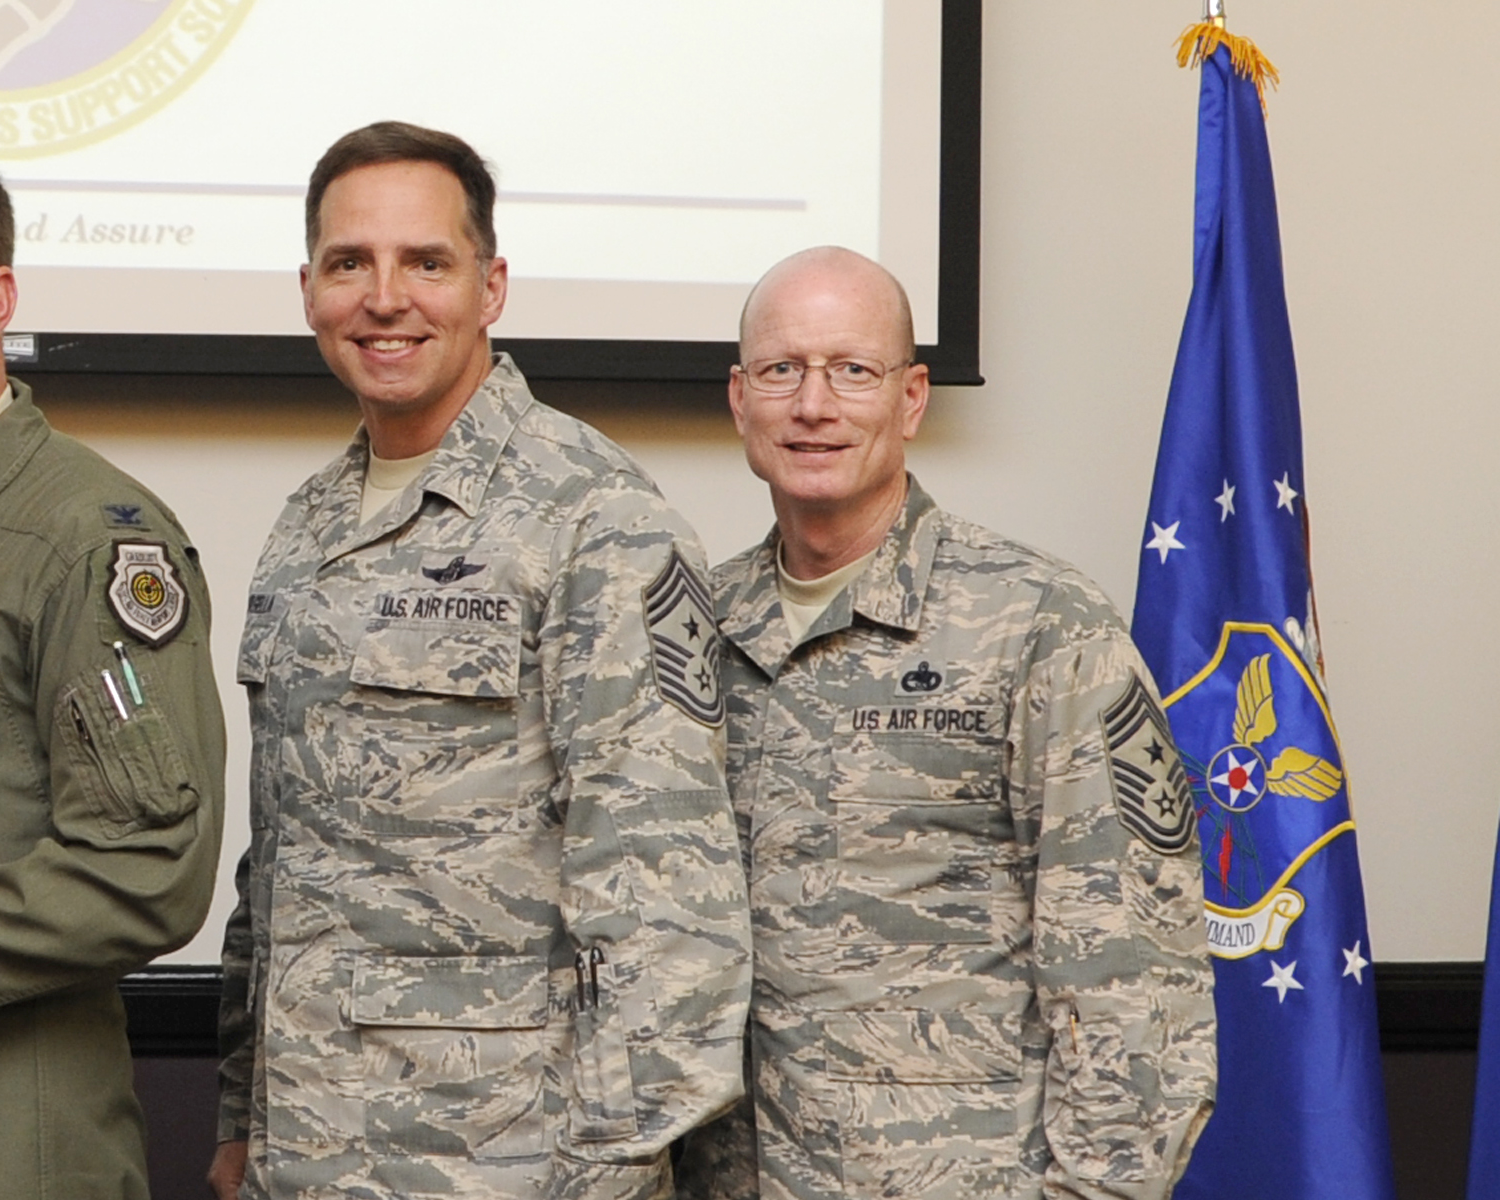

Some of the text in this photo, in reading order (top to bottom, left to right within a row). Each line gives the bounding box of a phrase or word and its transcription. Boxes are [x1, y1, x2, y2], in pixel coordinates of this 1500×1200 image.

[28, 31, 190, 142] SUPPORT
[58, 213, 195, 246] Assure
[411, 597, 442, 618] AIR
[445, 597, 509, 622] FORCE
[886, 708, 917, 730] AIR
[922, 708, 988, 732] FORCE
